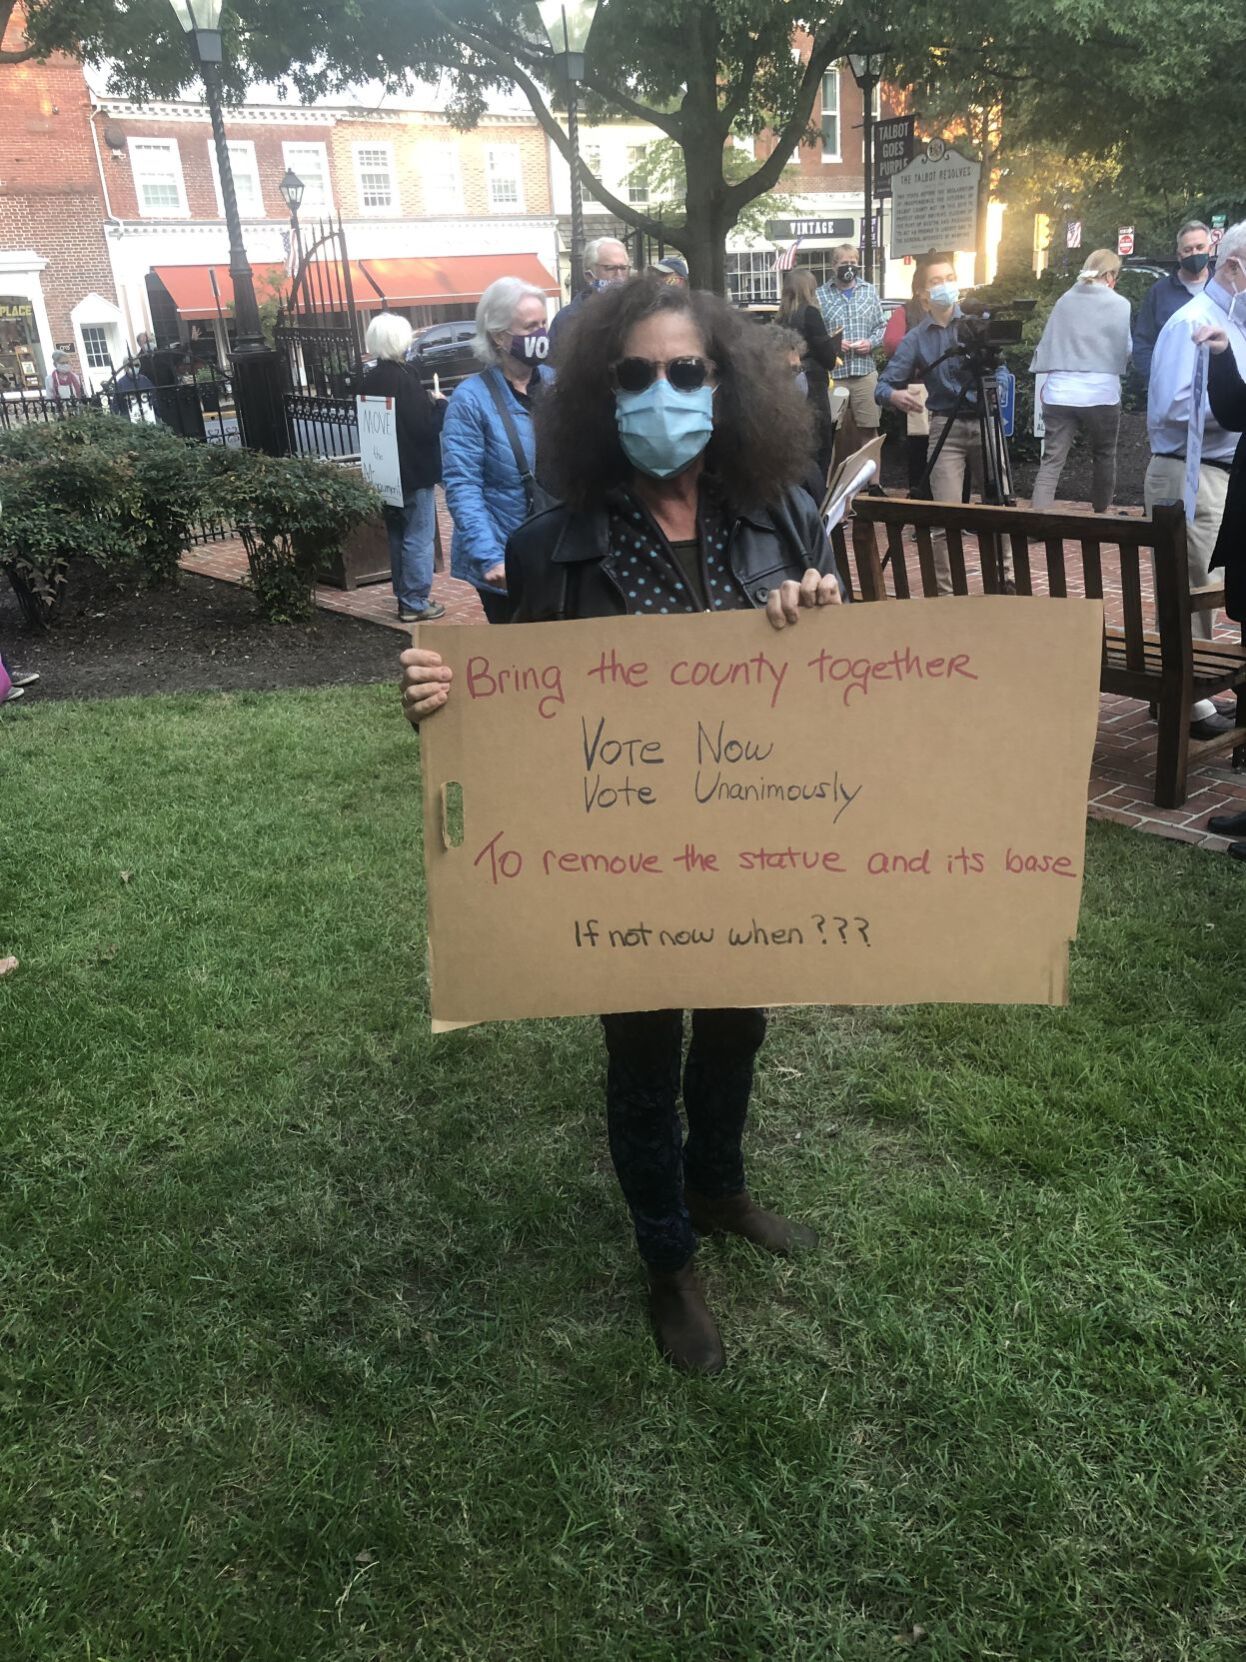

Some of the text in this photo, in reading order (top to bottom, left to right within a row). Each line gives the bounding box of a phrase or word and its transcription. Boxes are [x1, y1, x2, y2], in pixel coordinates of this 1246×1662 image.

[879, 122, 909, 141] TALBOT
[882, 141, 904, 158] GOES
[901, 173, 912, 185] THE
[914, 169, 937, 183] TALBOT
[939, 166, 972, 181] RESOLVES
[789, 221, 834, 235] VINTAGE
[0, 305, 32, 317] PLACE
[363, 409, 391, 435] MOVE
[467, 656, 564, 719] Bring
[588, 649, 648, 687] the
[671, 653, 788, 707] county
[698, 721, 773, 764] Now
[584, 771, 862, 823] Vote Unanimously
[474, 831, 1076, 884] To remove the statue and its base
[574, 919, 599, 947] If
[609, 922, 652, 947] not
[660, 928, 714, 945] now
